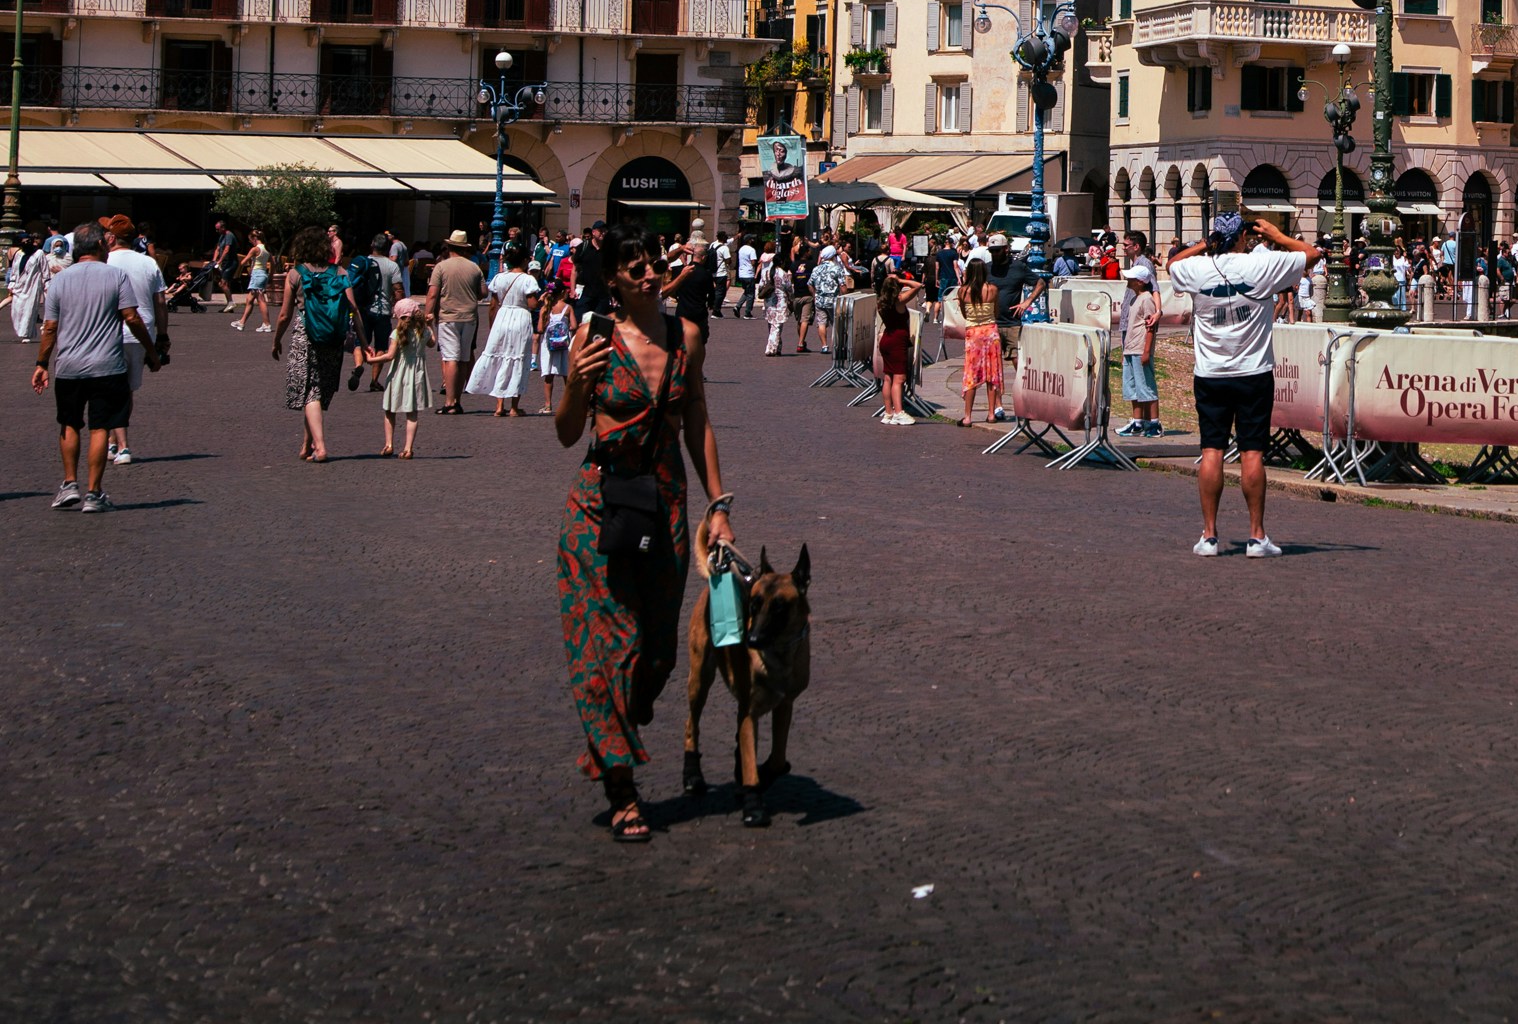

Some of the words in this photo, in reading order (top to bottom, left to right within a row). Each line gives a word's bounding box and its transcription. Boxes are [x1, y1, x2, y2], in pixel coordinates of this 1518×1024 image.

[622, 178, 658, 188] LUSH
[1376, 364, 1456, 392] Arena
[1460, 377, 1476, 393] di
[1400, 387, 1488, 426] Opera
